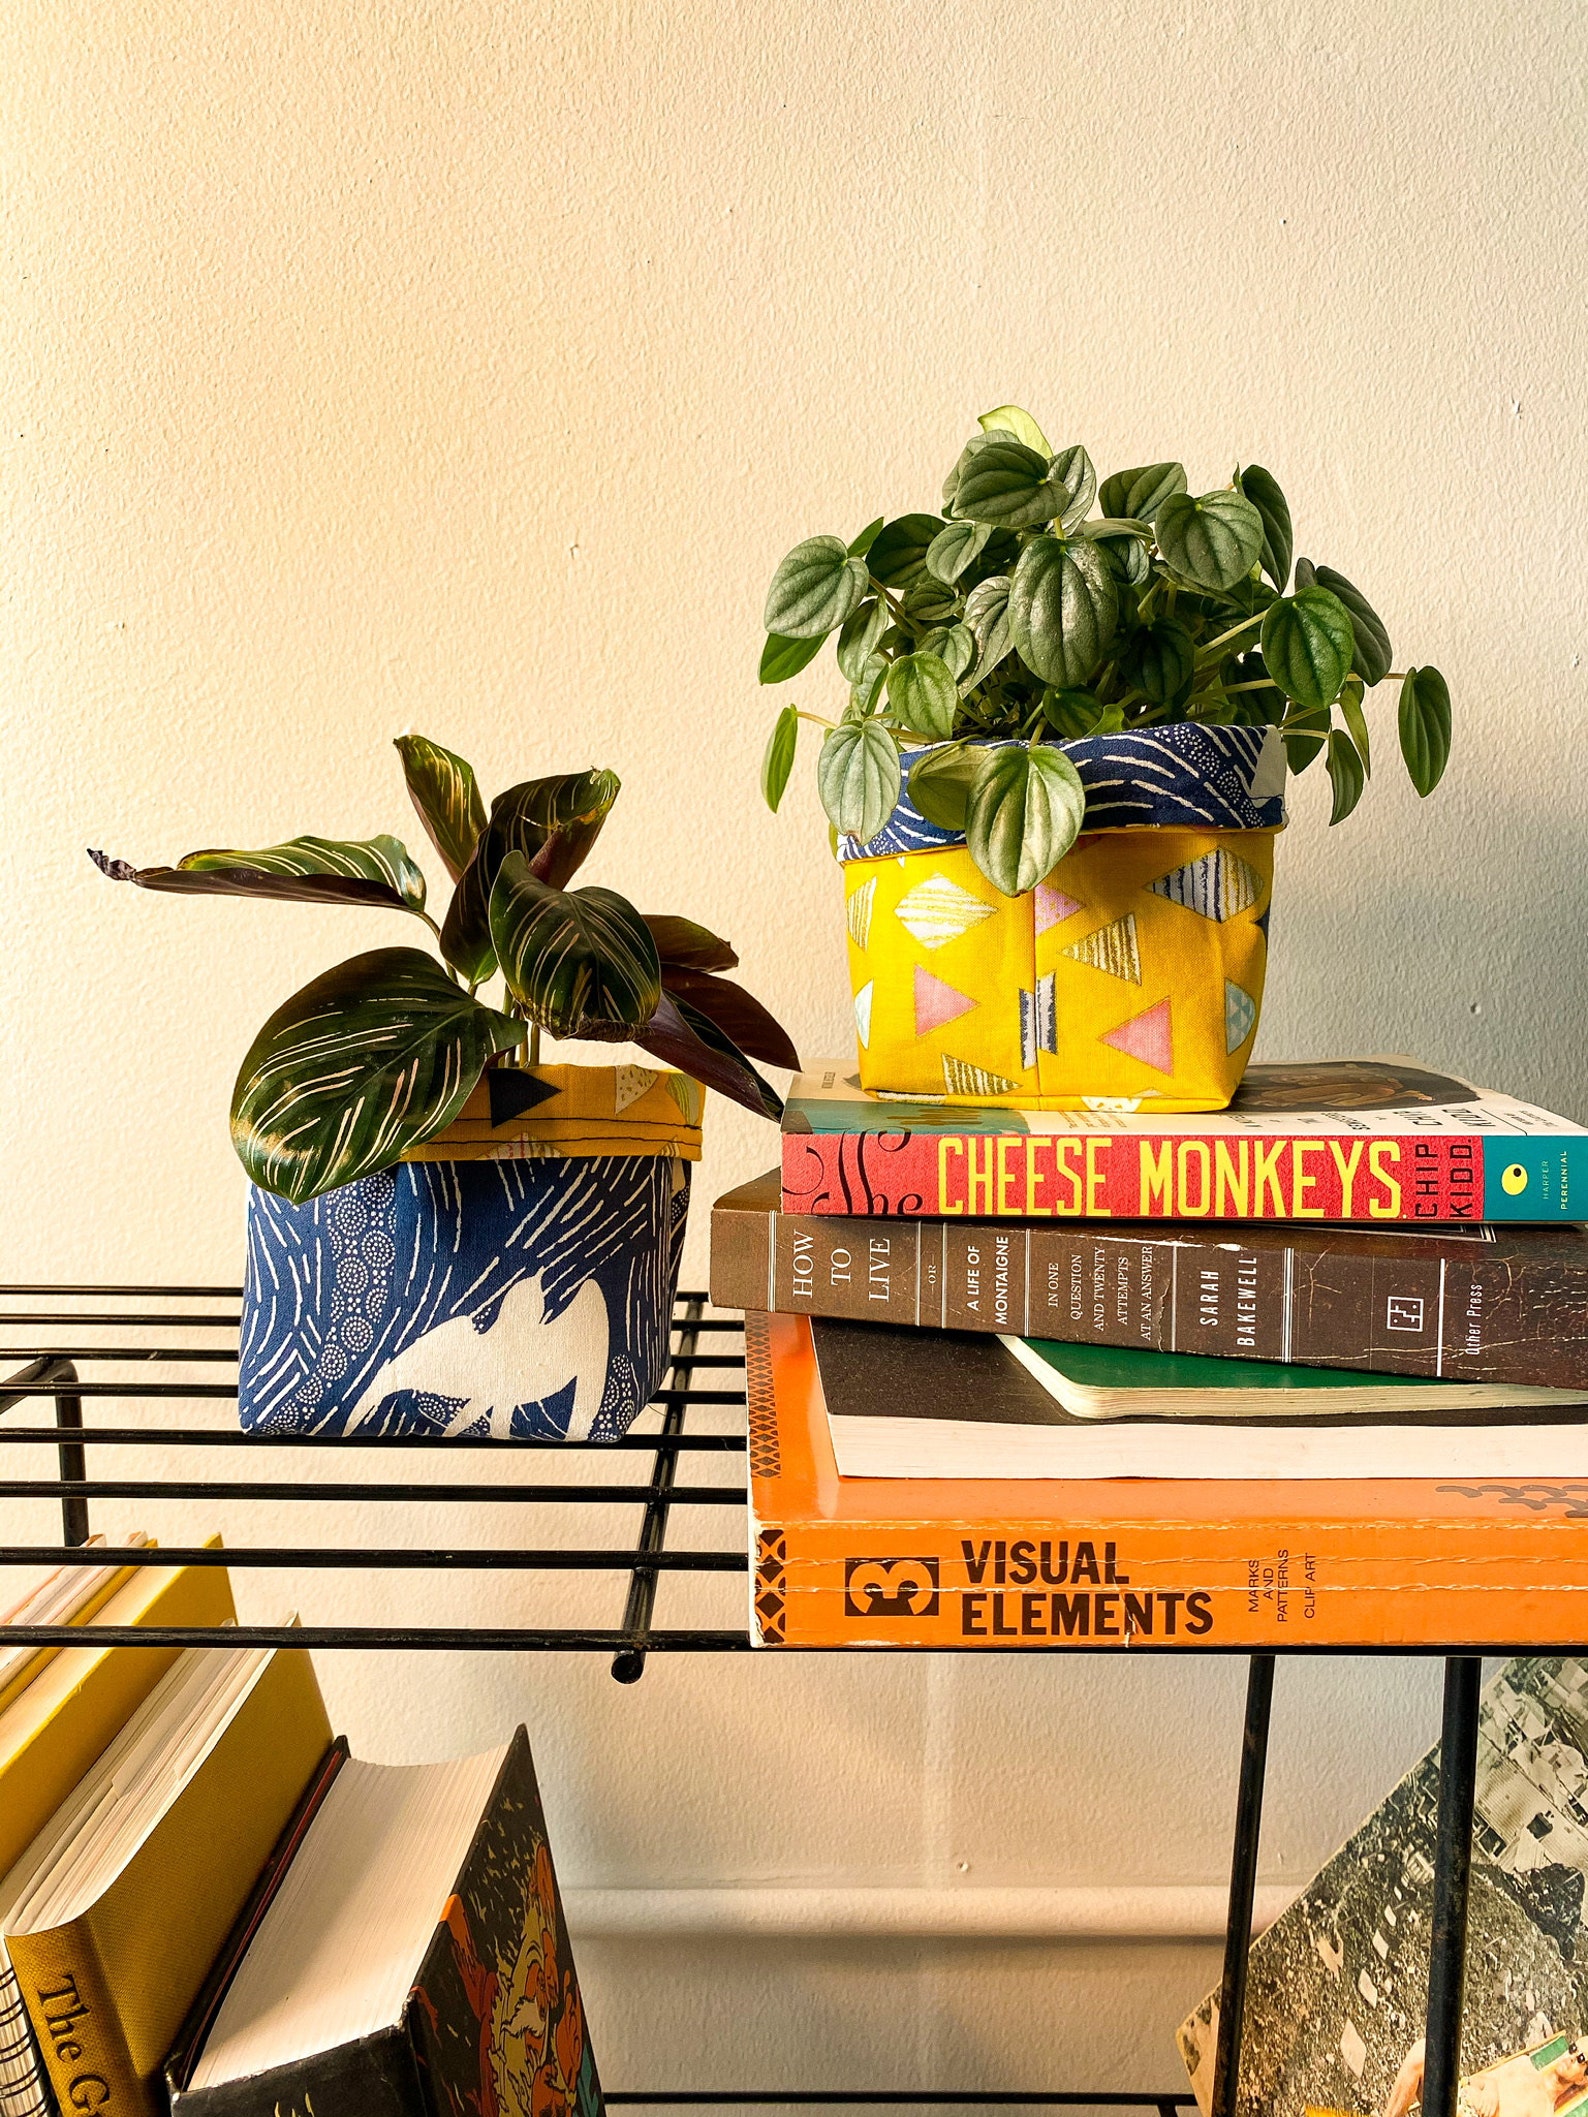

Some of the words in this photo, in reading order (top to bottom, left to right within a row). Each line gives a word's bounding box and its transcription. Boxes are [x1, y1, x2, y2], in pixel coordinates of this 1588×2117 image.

[938, 1137, 1112, 1217] CHEESE
[1415, 1143, 1438, 1218] CHIP
[1560, 1151, 1568, 1210] PERENNIAL
[793, 1229, 814, 1298] HOW
[830, 1248, 852, 1286] TO
[869, 1237, 891, 1302] LIVE
[928, 1264, 937, 1284] OR
[967, 1245, 980, 1263] OF
[1049, 1262, 1059, 1290] ONE
[1094, 1246, 1106, 1299] TWENTY
[1142, 1246, 1153, 1300] ANSWER
[967, 1269, 980, 1295] LIFE
[994, 1236, 1009, 1325] MONTAIGNE
[1049, 1291, 1058, 1307] IN
[1070, 1254, 1083, 1320] QUESTION
[1117, 1256, 1129, 1325] ATTEMPTS
[1200, 1270, 1219, 1326] SARAH
[1237, 1257, 1258, 1346] BAKEWELL
[1467, 1284, 1483, 1317] Press
[966, 1299, 979, 1311] A
[1093, 1302, 1105, 1332] AND
[1141, 1302, 1152, 1321] AN
[1140, 1324, 1151, 1341] AT
[1464, 1324, 1482, 1355] Other
[961, 1540, 1130, 1584] VISUAL
[1263, 1567, 1273, 1600] AND
[1305, 1552, 1316, 1582] ART
[1248, 1559, 1259, 1612] MARKS
[1277, 1549, 1288, 1622] PATTERNS
[1304, 1586, 1315, 1618] CLIP
[961, 1592, 1213, 1636] ELEMENTS
[37, 1973, 91, 2063] The
[69, 2074, 112, 2117] G
